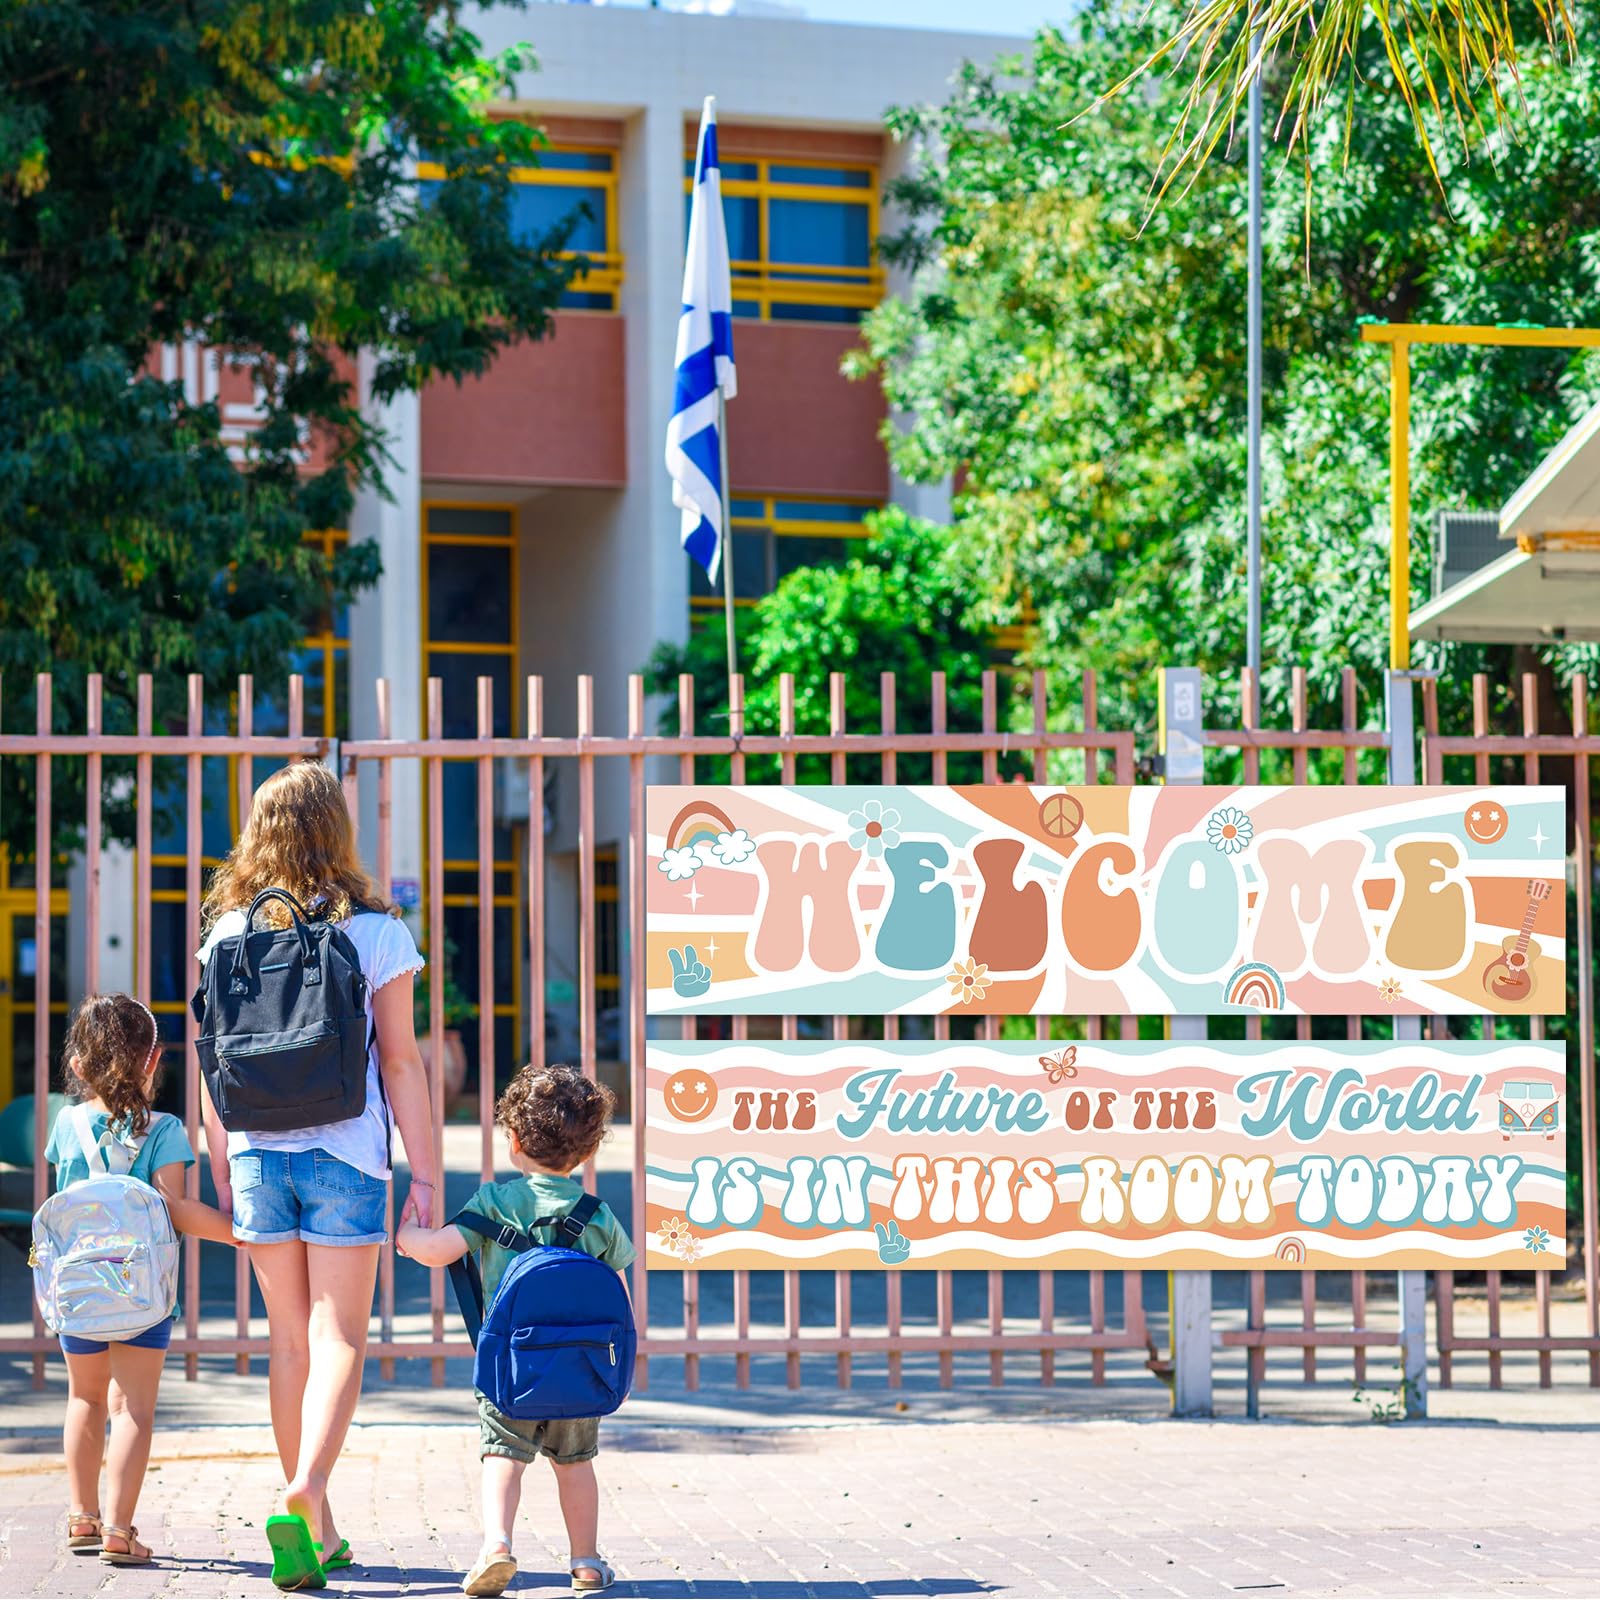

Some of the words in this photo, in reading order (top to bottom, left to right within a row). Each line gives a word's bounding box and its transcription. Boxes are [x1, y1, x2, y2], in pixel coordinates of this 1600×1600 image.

[752, 837, 1468, 976] WELCOME
[731, 1091, 816, 1131] THE
[836, 1068, 1050, 1138] Future
[1065, 1091, 1117, 1130] OF
[1132, 1091, 1217, 1130] THE
[1236, 1068, 1483, 1140] World
[686, 1156, 764, 1230] IS
[781, 1155, 871, 1230] IN
[892, 1153, 1061, 1225] THIS
[1078, 1154, 1276, 1230] ROOM
[1295, 1155, 1524, 1231] TODAY
